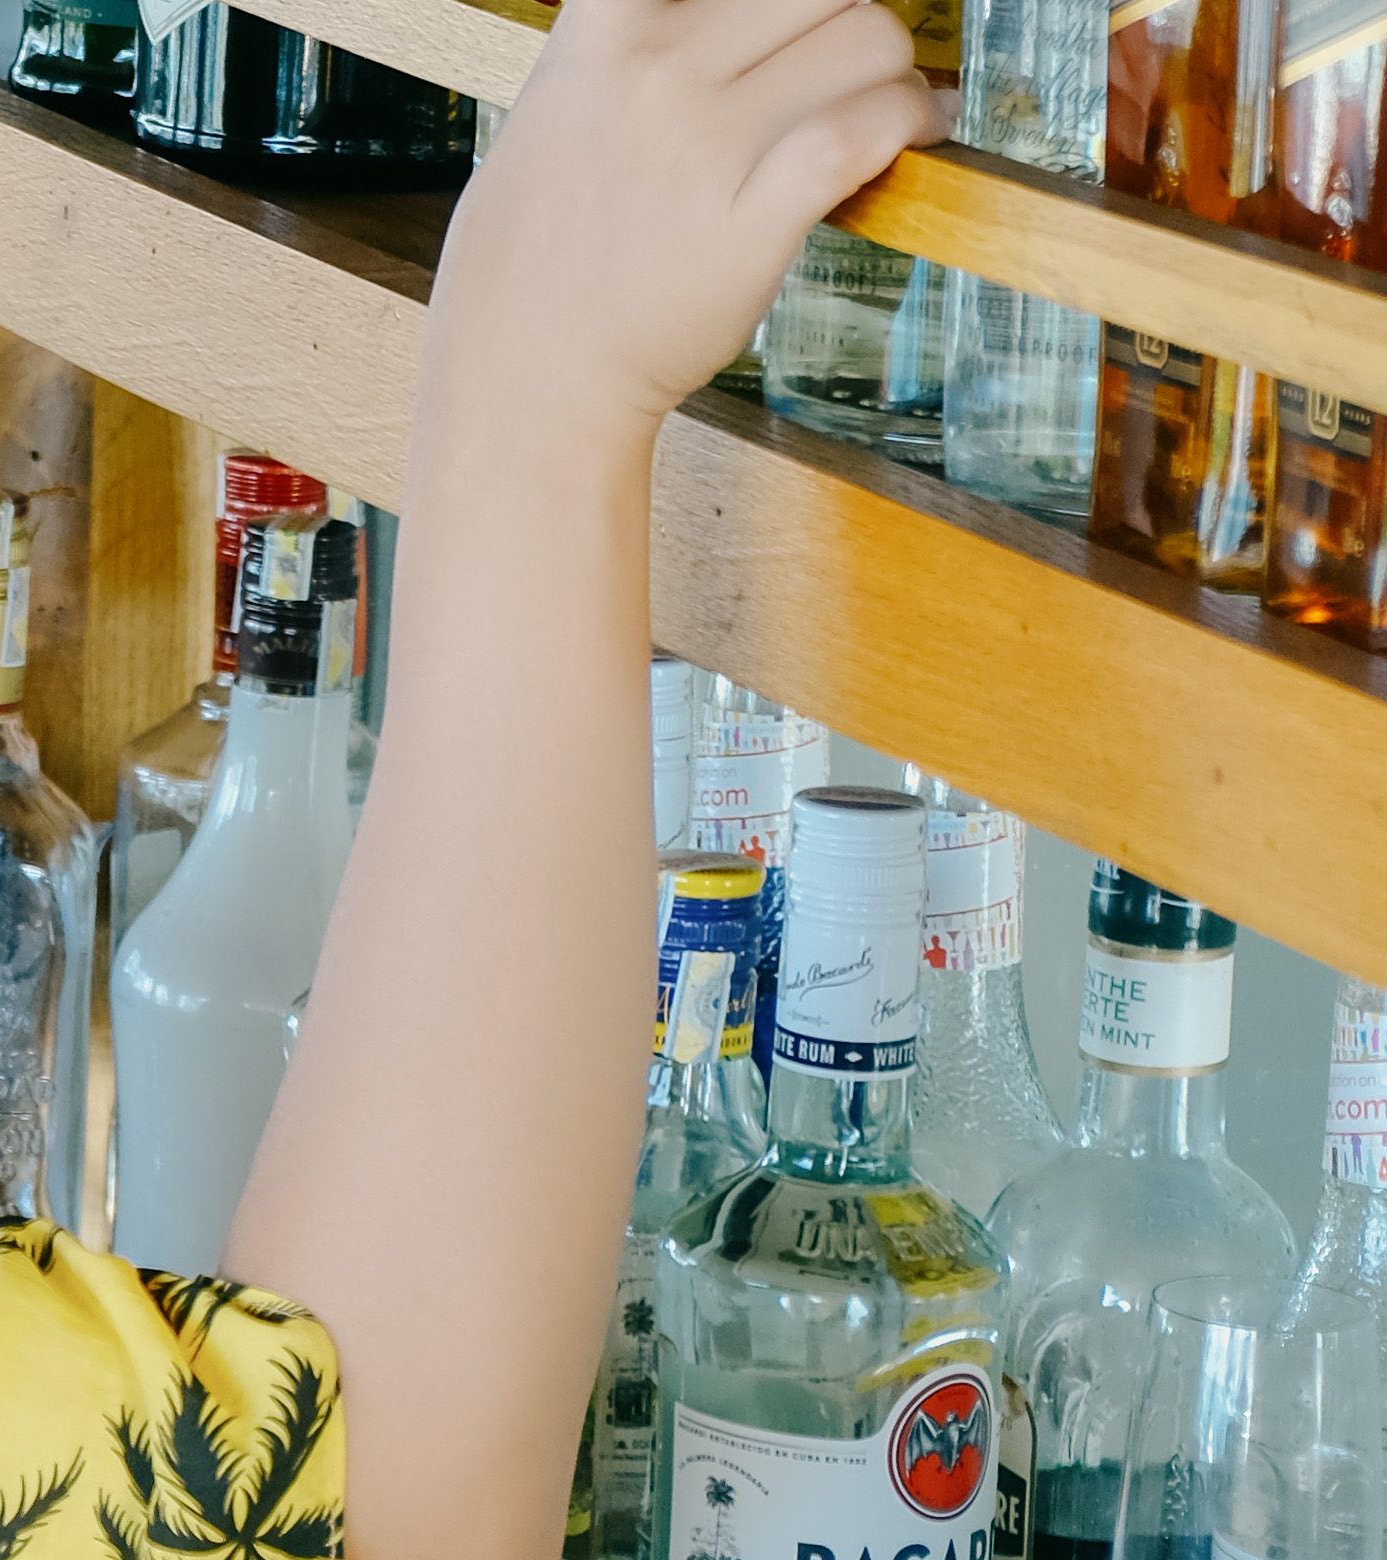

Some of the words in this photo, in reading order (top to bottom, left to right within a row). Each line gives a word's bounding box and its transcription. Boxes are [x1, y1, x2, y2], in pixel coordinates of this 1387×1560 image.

[1101, 1024, 1156, 1050] MINT
[798, 1038, 835, 1065] RUM
[793, 1451, 820, 1463] CUBA
